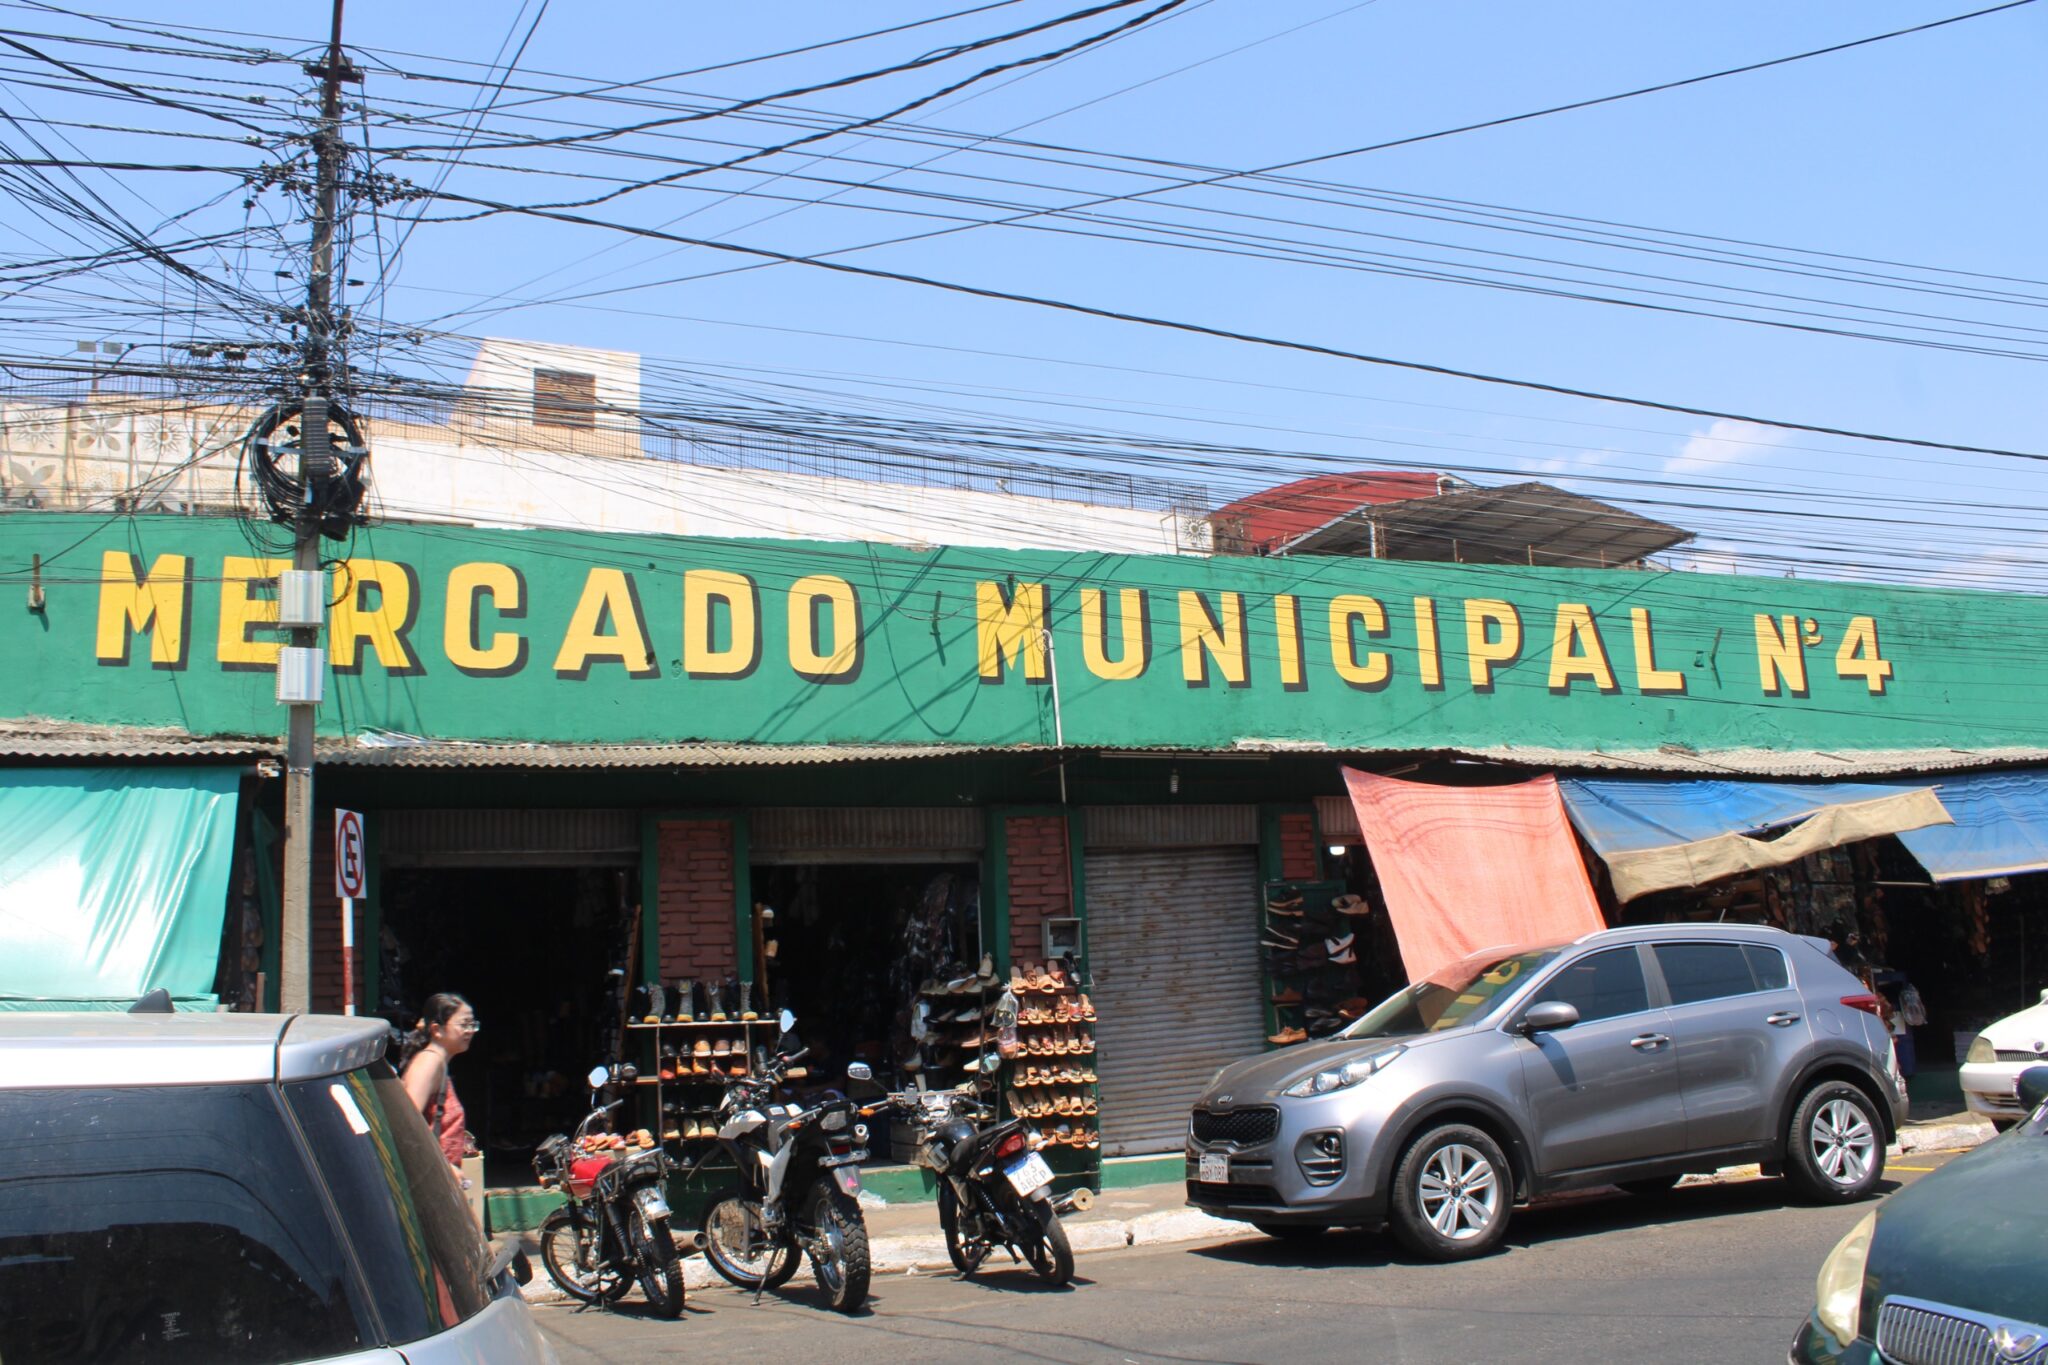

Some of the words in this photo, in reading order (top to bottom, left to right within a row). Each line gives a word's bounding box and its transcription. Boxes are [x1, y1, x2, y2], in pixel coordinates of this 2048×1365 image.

[96, 550, 864, 684] MERCADO
[976, 581, 1688, 696] MUNICIPAL
[1836, 616, 1894, 696] 4
